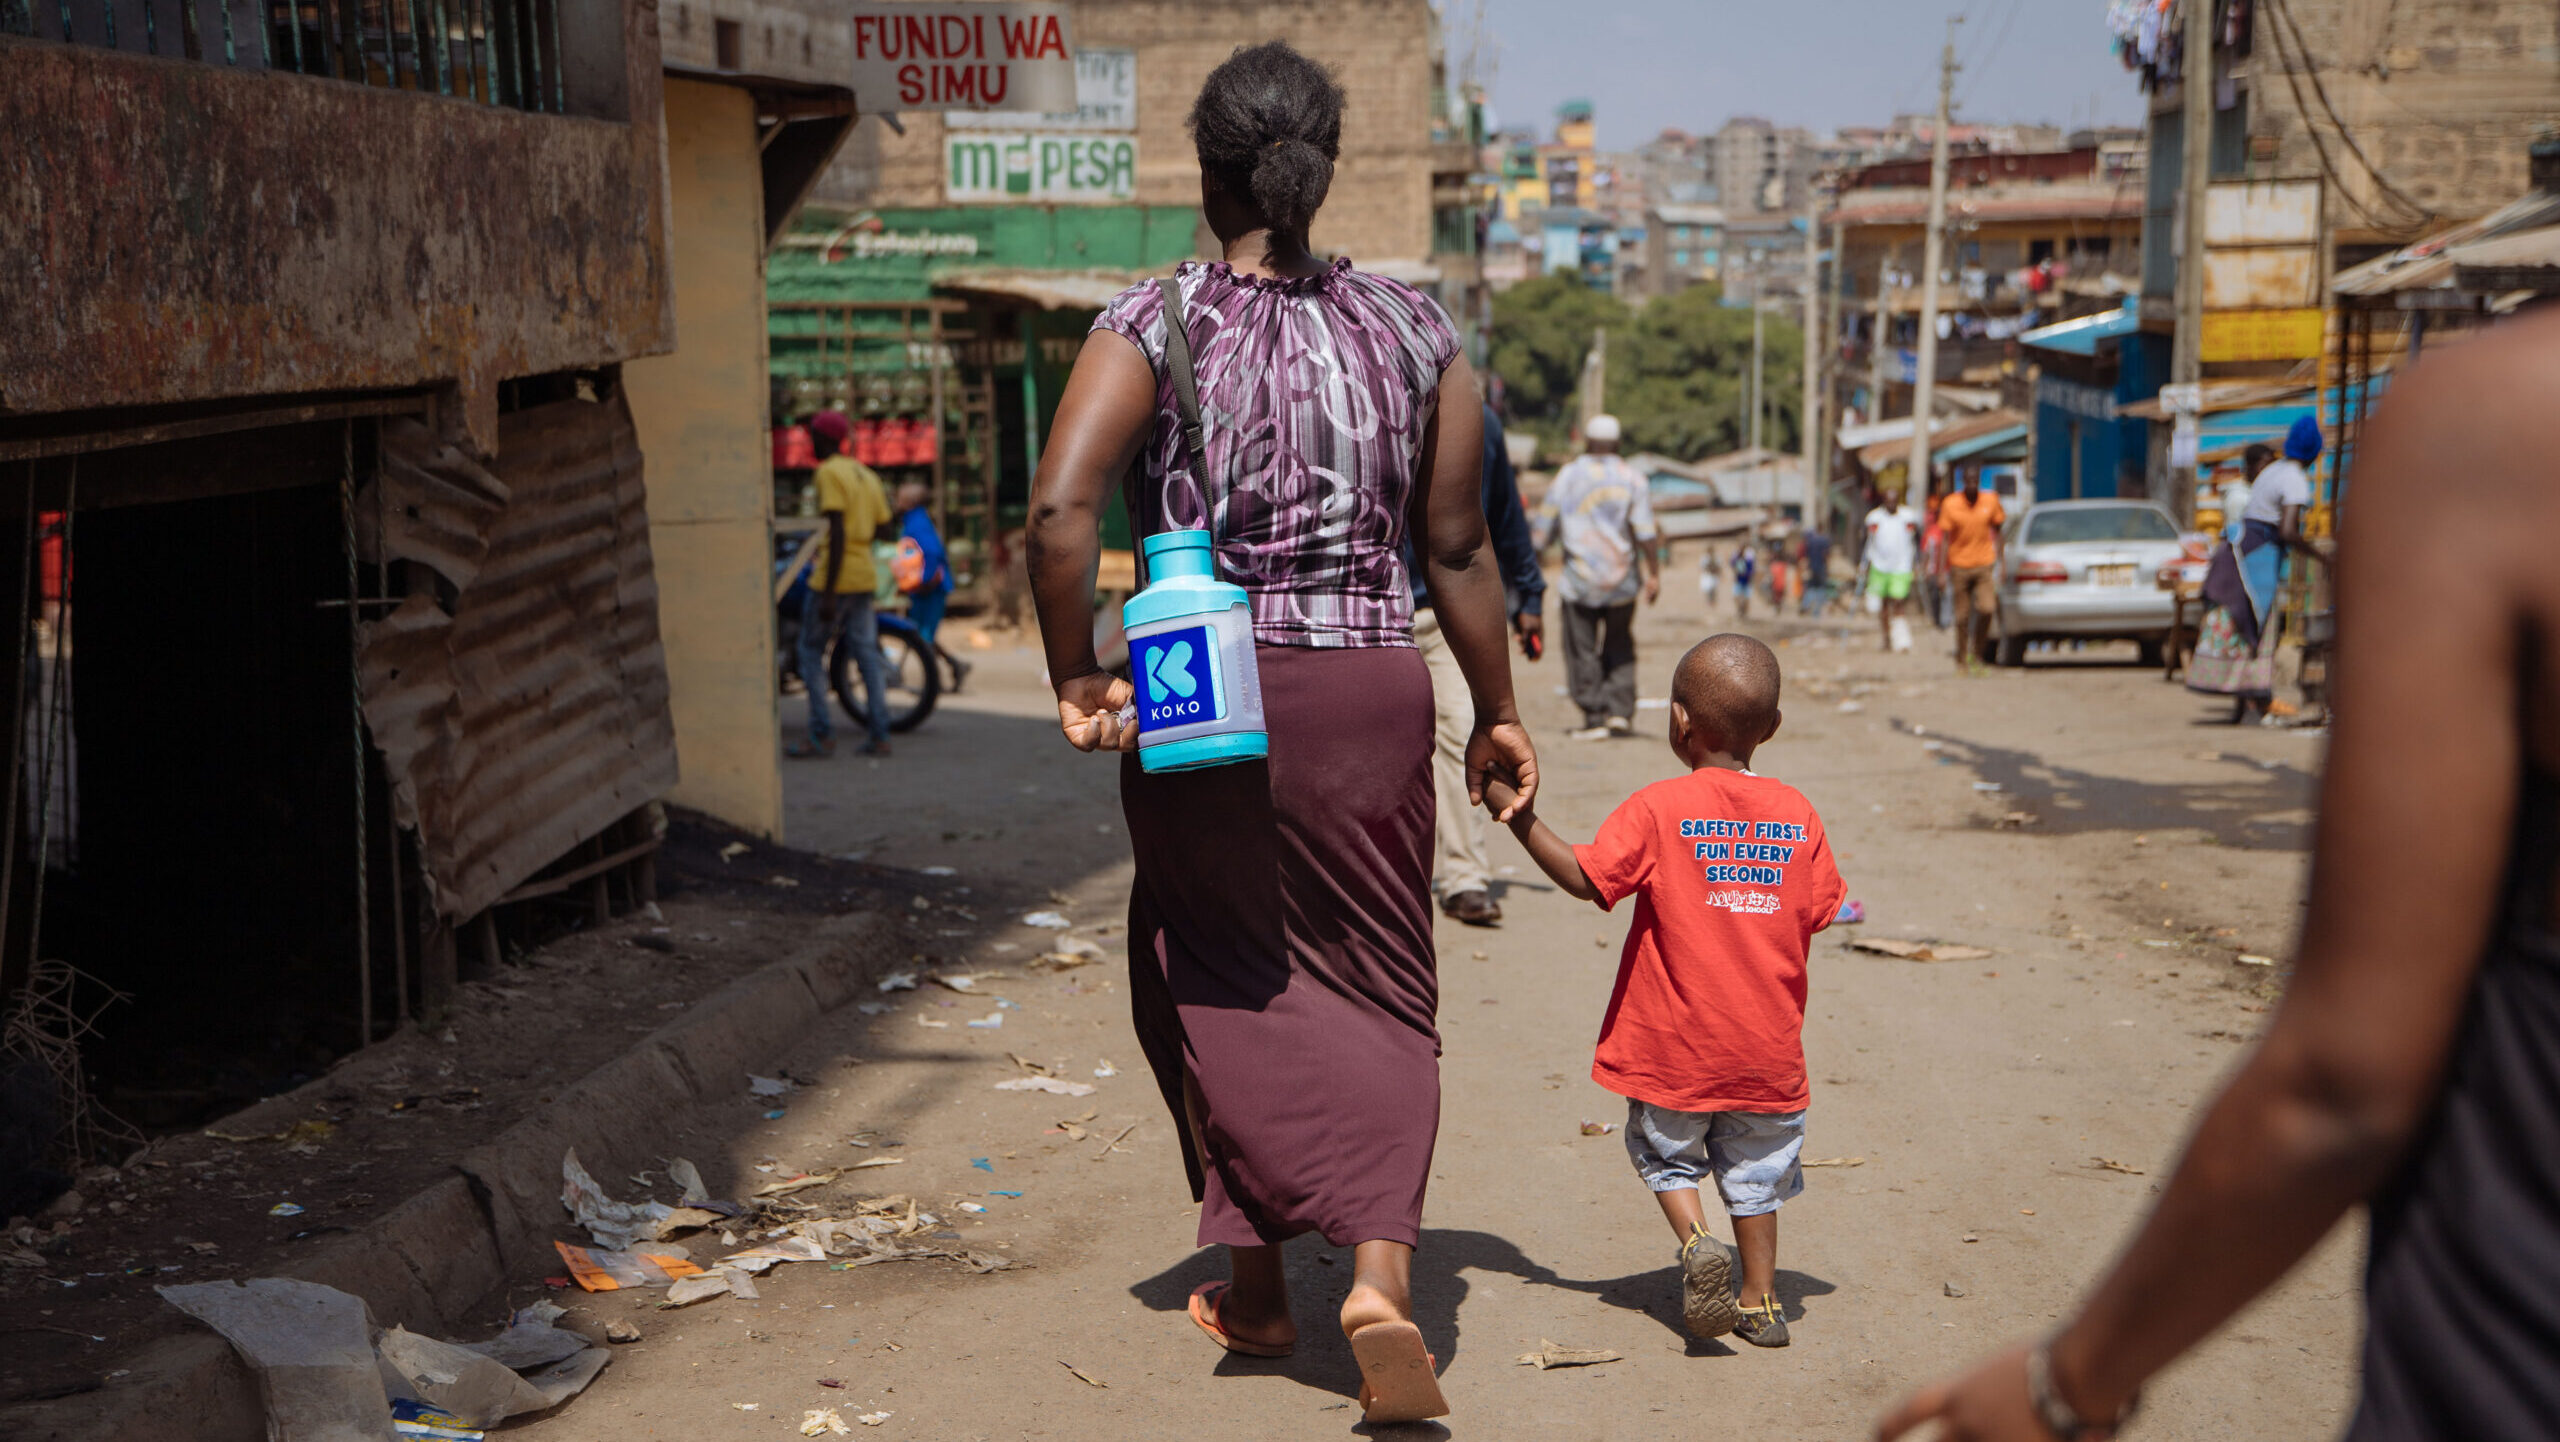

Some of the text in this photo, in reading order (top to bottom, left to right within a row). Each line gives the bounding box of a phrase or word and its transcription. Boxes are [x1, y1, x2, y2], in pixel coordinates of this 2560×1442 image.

[854, 14, 1070, 60] FUNDI WA
[898, 65, 1009, 105] SIMU
[1151, 700, 1201, 722] KOKO
[1680, 819, 1808, 843] SAFETY FIRST,
[1695, 842, 1795, 864] FUN EVERY
[1706, 865, 1783, 886] SECOND!
